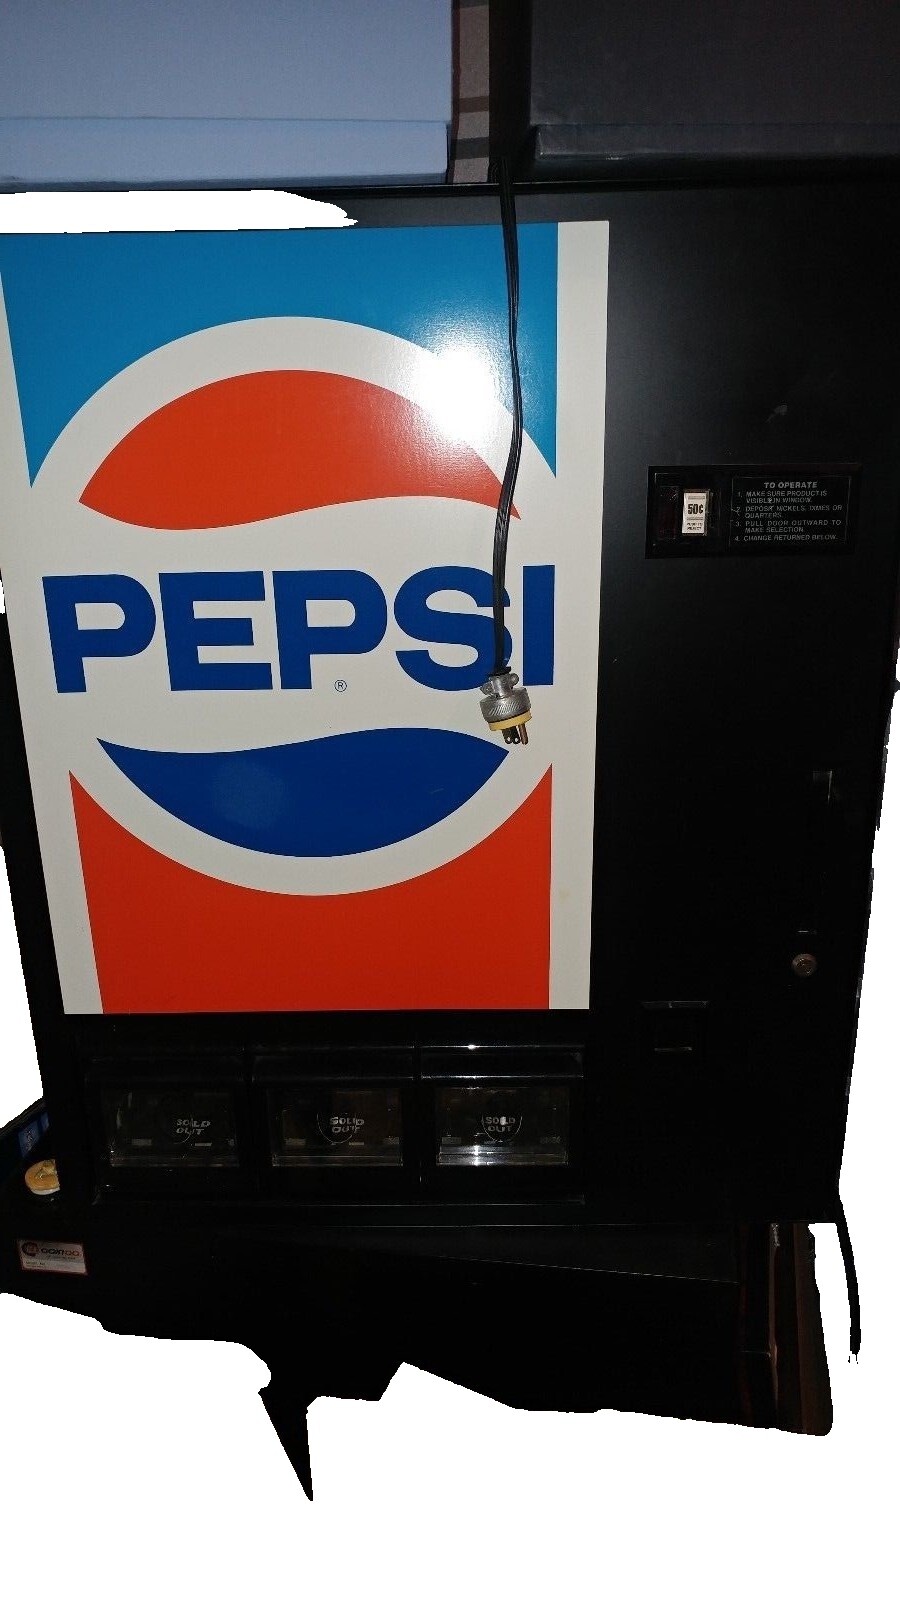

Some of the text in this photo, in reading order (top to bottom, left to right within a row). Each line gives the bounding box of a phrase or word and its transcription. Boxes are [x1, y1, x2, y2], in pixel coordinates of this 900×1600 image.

[778, 481, 818, 489] OPERATE
[688, 503, 704, 515] 50¢
[767, 519, 789, 527] DOOR
[42, 564, 556, 693] PEPSI
[176, 1118, 212, 1128] SOLD
[485, 1116, 516, 1126] SOLD
[176, 1127, 205, 1135] OUT
[487, 1125, 513, 1133] OUT
